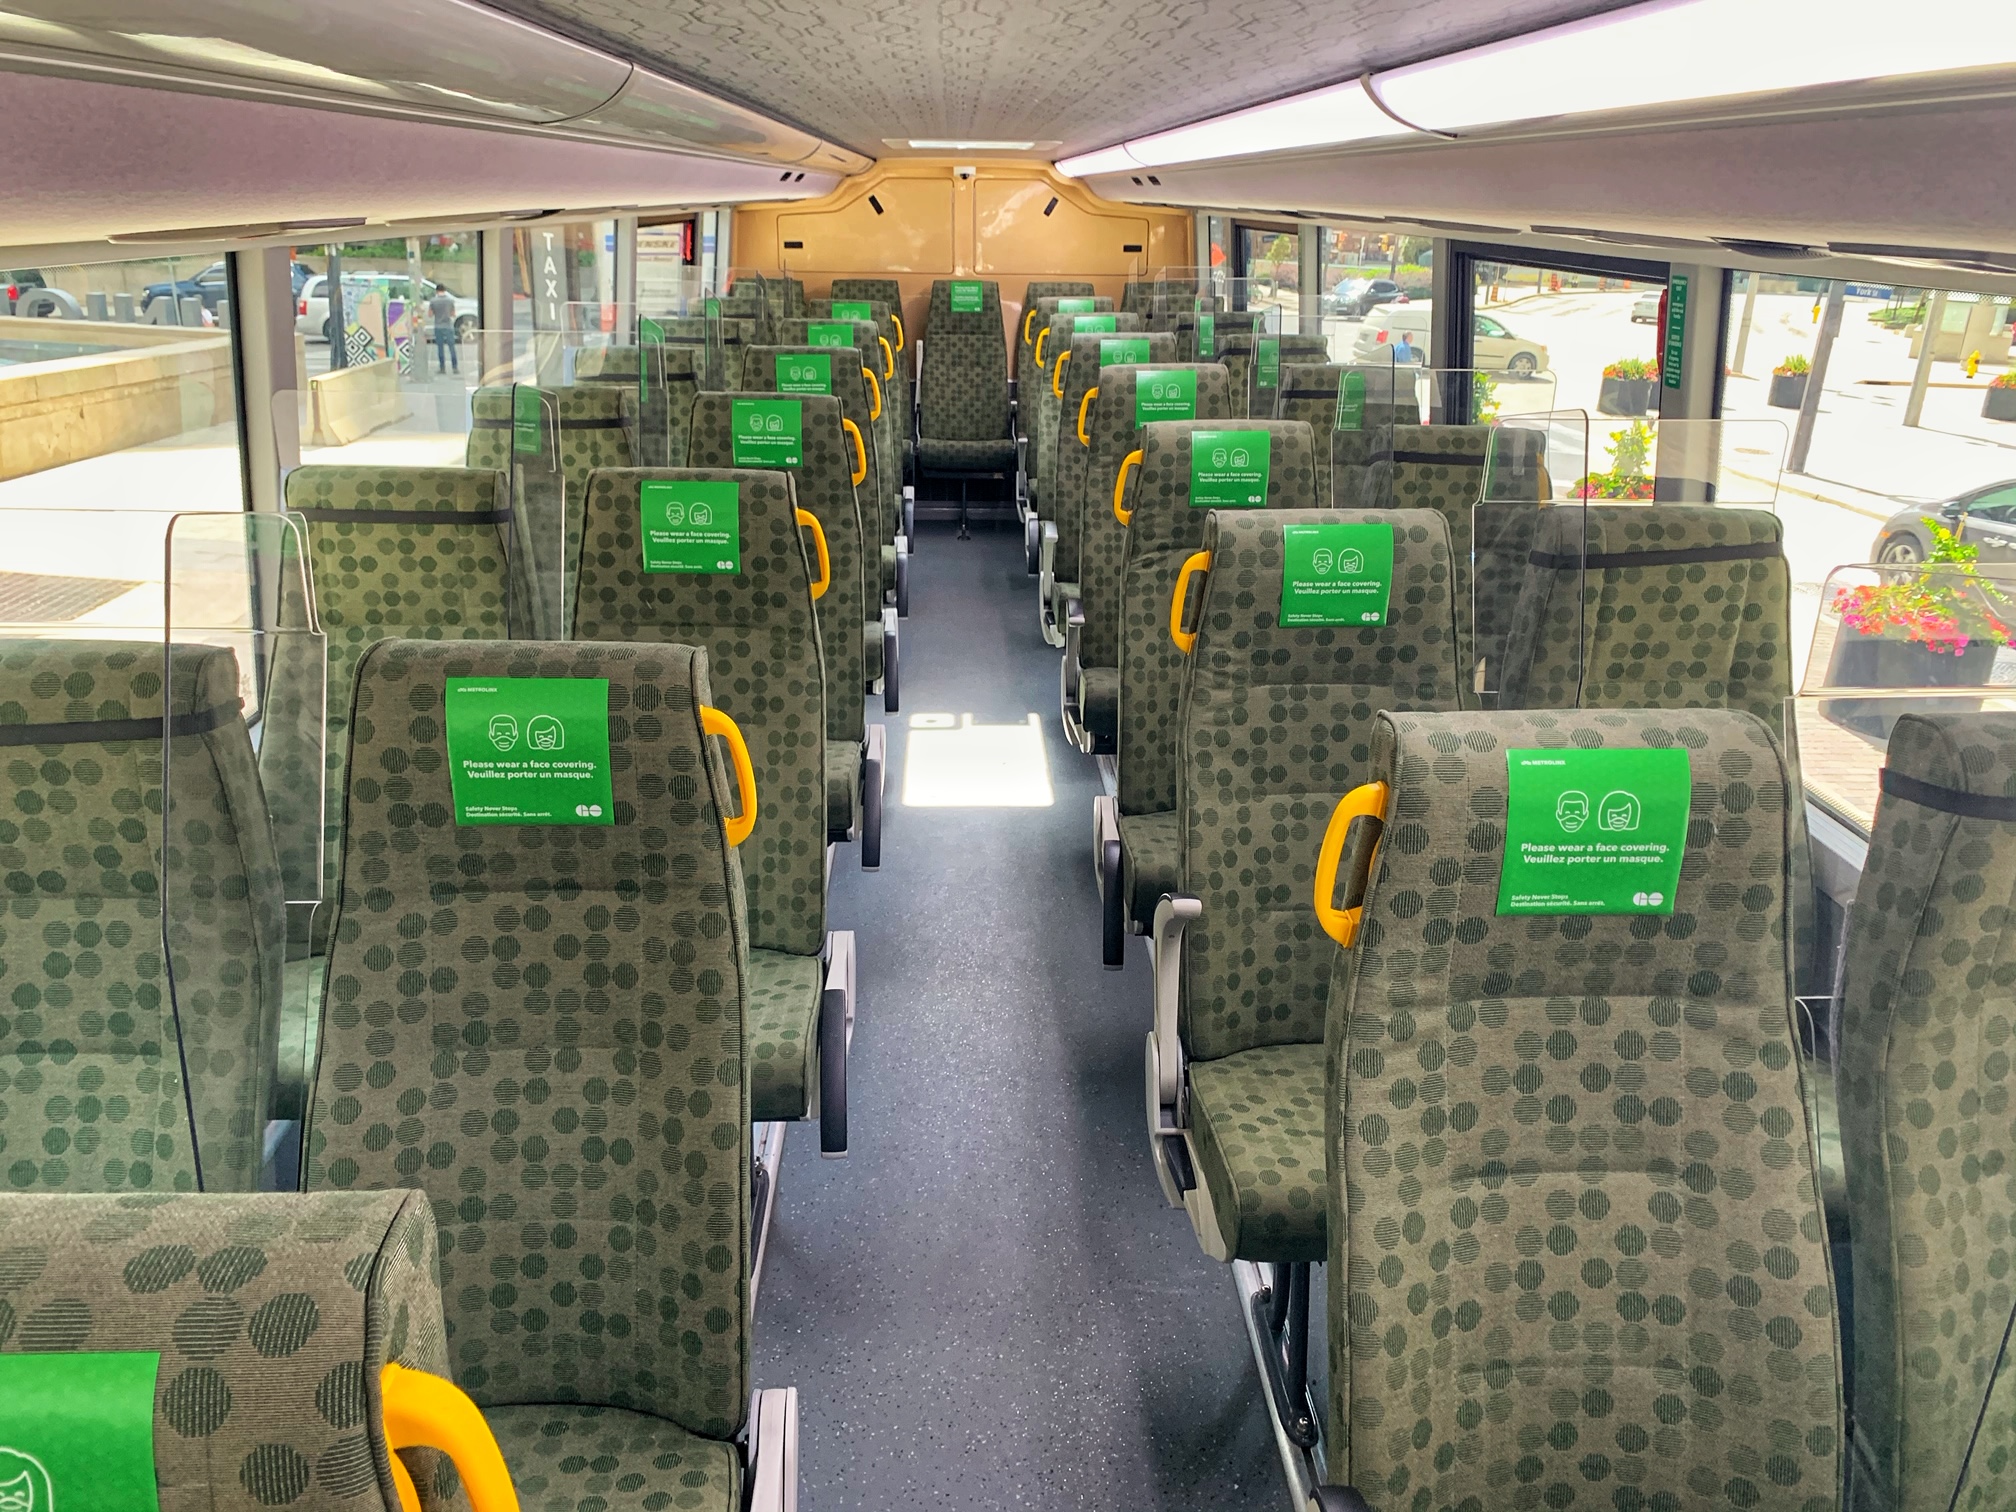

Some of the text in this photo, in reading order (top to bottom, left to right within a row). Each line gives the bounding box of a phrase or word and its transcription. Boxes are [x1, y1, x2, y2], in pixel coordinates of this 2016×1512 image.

[542, 232, 558, 321] TAXI
[463, 760, 494, 768] Please
[530, 760, 550, 768] face
[553, 760, 597, 770] covering.
[467, 770, 505, 778] Veuillez
[508, 771, 537, 780] porter
[554, 772, 594, 780] masque.
[1521, 843, 1555, 852] Please
[1595, 843, 1617, 851] face
[1620, 843, 1669, 853] covering.
[1523, 855, 1564, 863] Veuillez
[1567, 856, 1600, 865] porter
[1619, 856, 1663, 865] masque.
